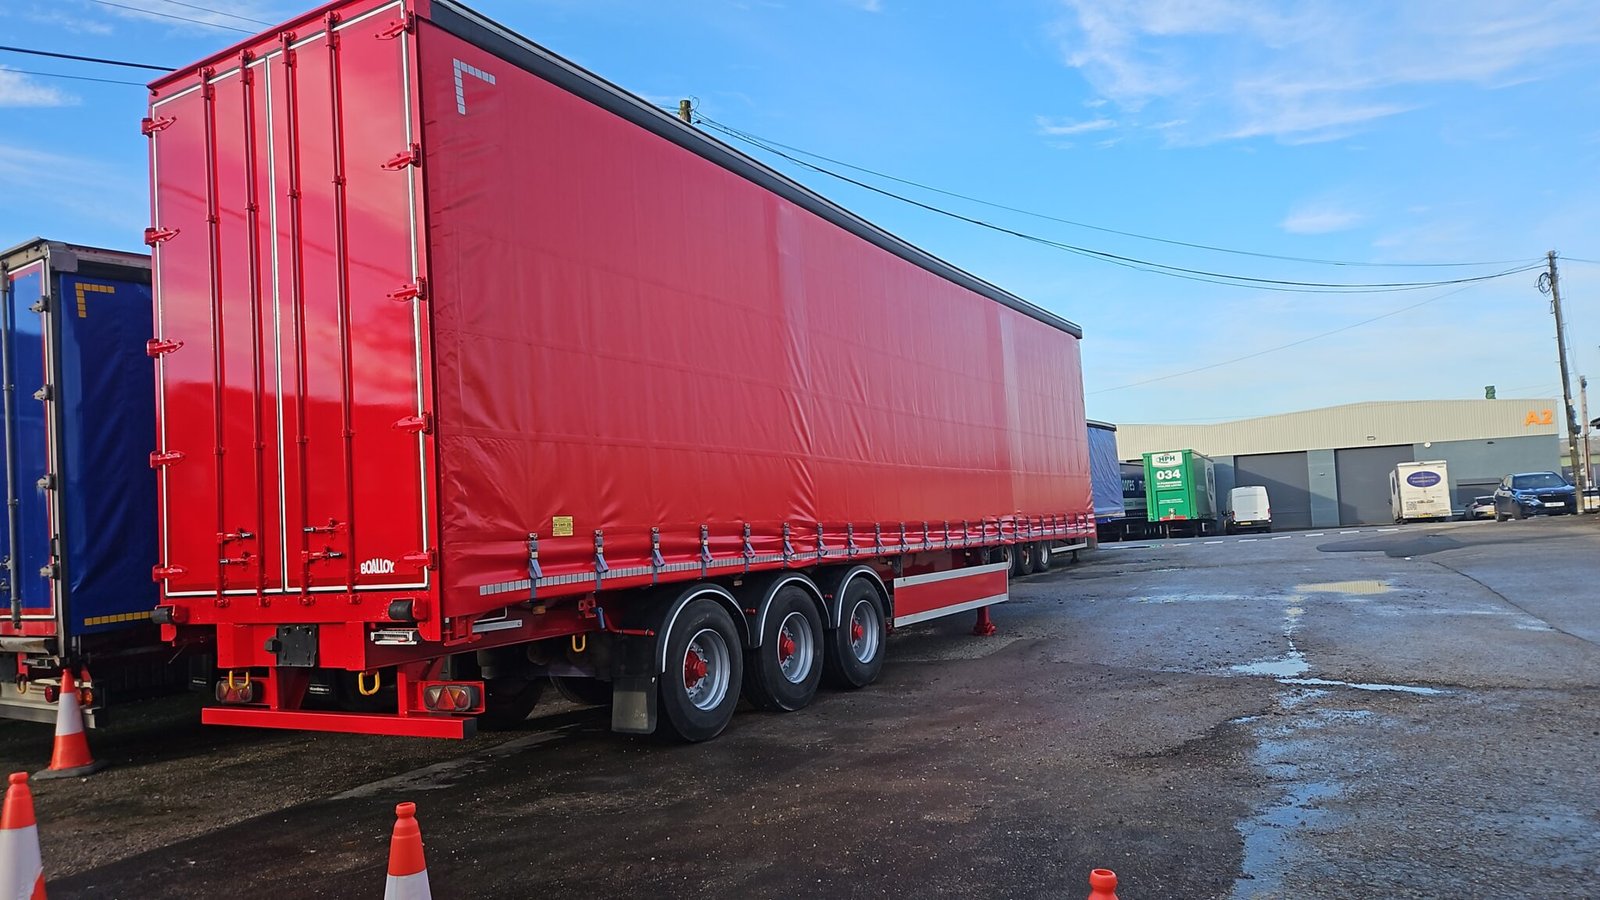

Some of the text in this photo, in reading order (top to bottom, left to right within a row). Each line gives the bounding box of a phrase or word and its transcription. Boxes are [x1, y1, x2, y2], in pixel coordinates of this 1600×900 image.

[1525, 409, 1553, 426] A2
[1156, 469, 1181, 480] 034
[360, 558, 395, 575] BOALLOY
